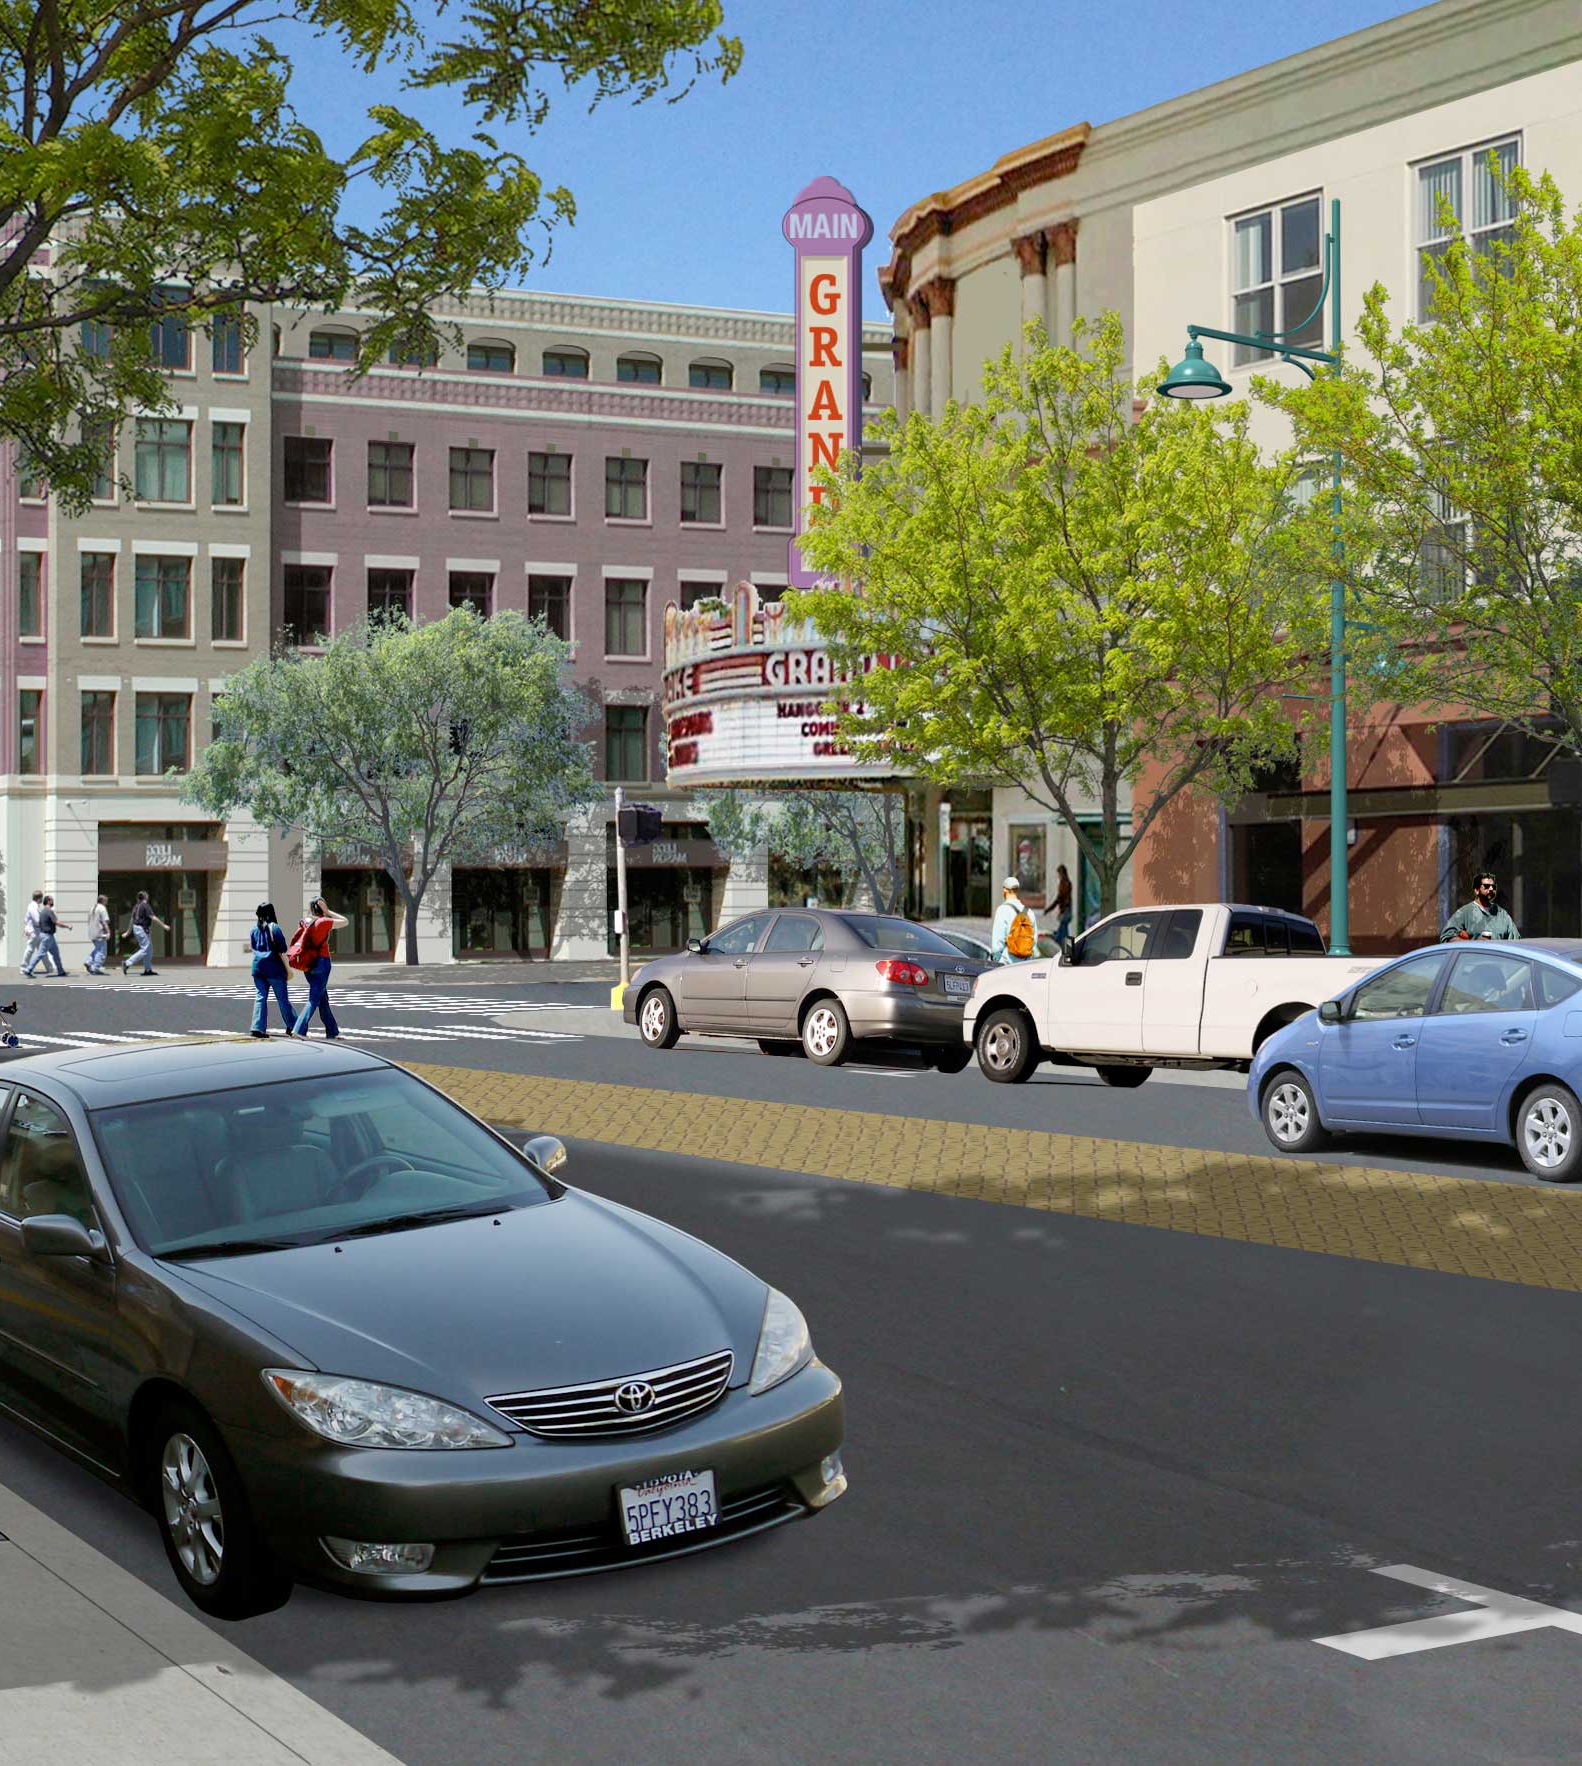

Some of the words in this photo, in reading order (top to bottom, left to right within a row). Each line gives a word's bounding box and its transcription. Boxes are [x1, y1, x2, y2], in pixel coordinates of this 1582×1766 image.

[789, 213, 858, 239] MAIN
[626, 1489, 712, 1534] 5PFY383
[629, 1513, 718, 1546] BERKELEY
